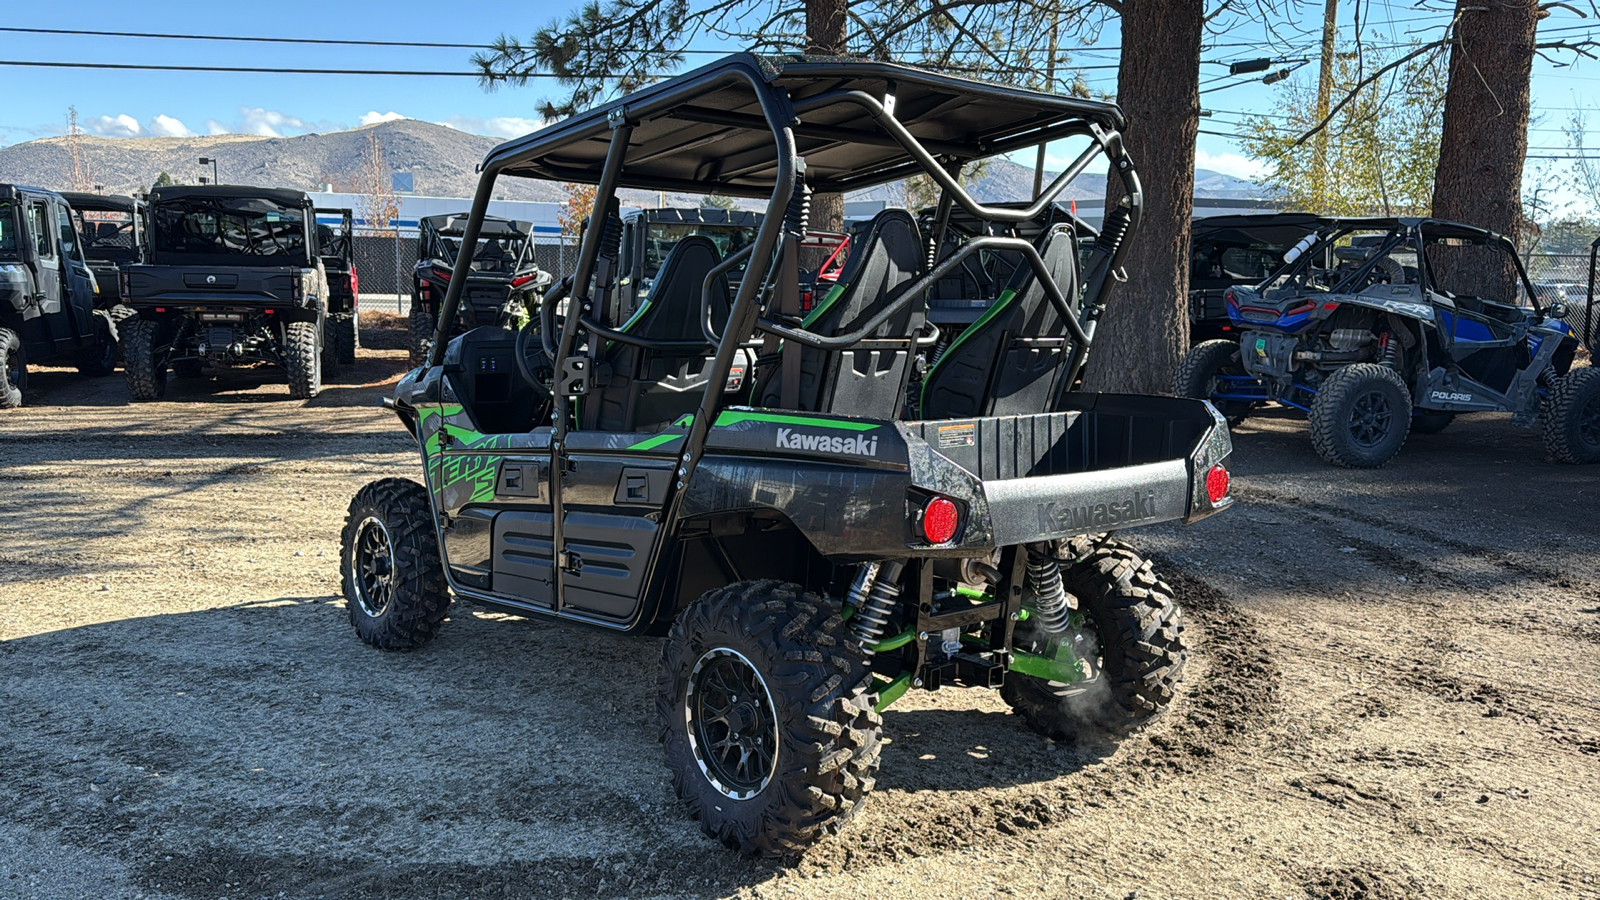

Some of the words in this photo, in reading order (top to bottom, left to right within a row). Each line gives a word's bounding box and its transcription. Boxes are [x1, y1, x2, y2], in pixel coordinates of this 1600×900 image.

[1383, 300, 1430, 316] RZR
[1431, 390, 1472, 402] POLARIS
[776, 428, 878, 457] Kawasaki
[1037, 489, 1156, 534] Kawasaki
